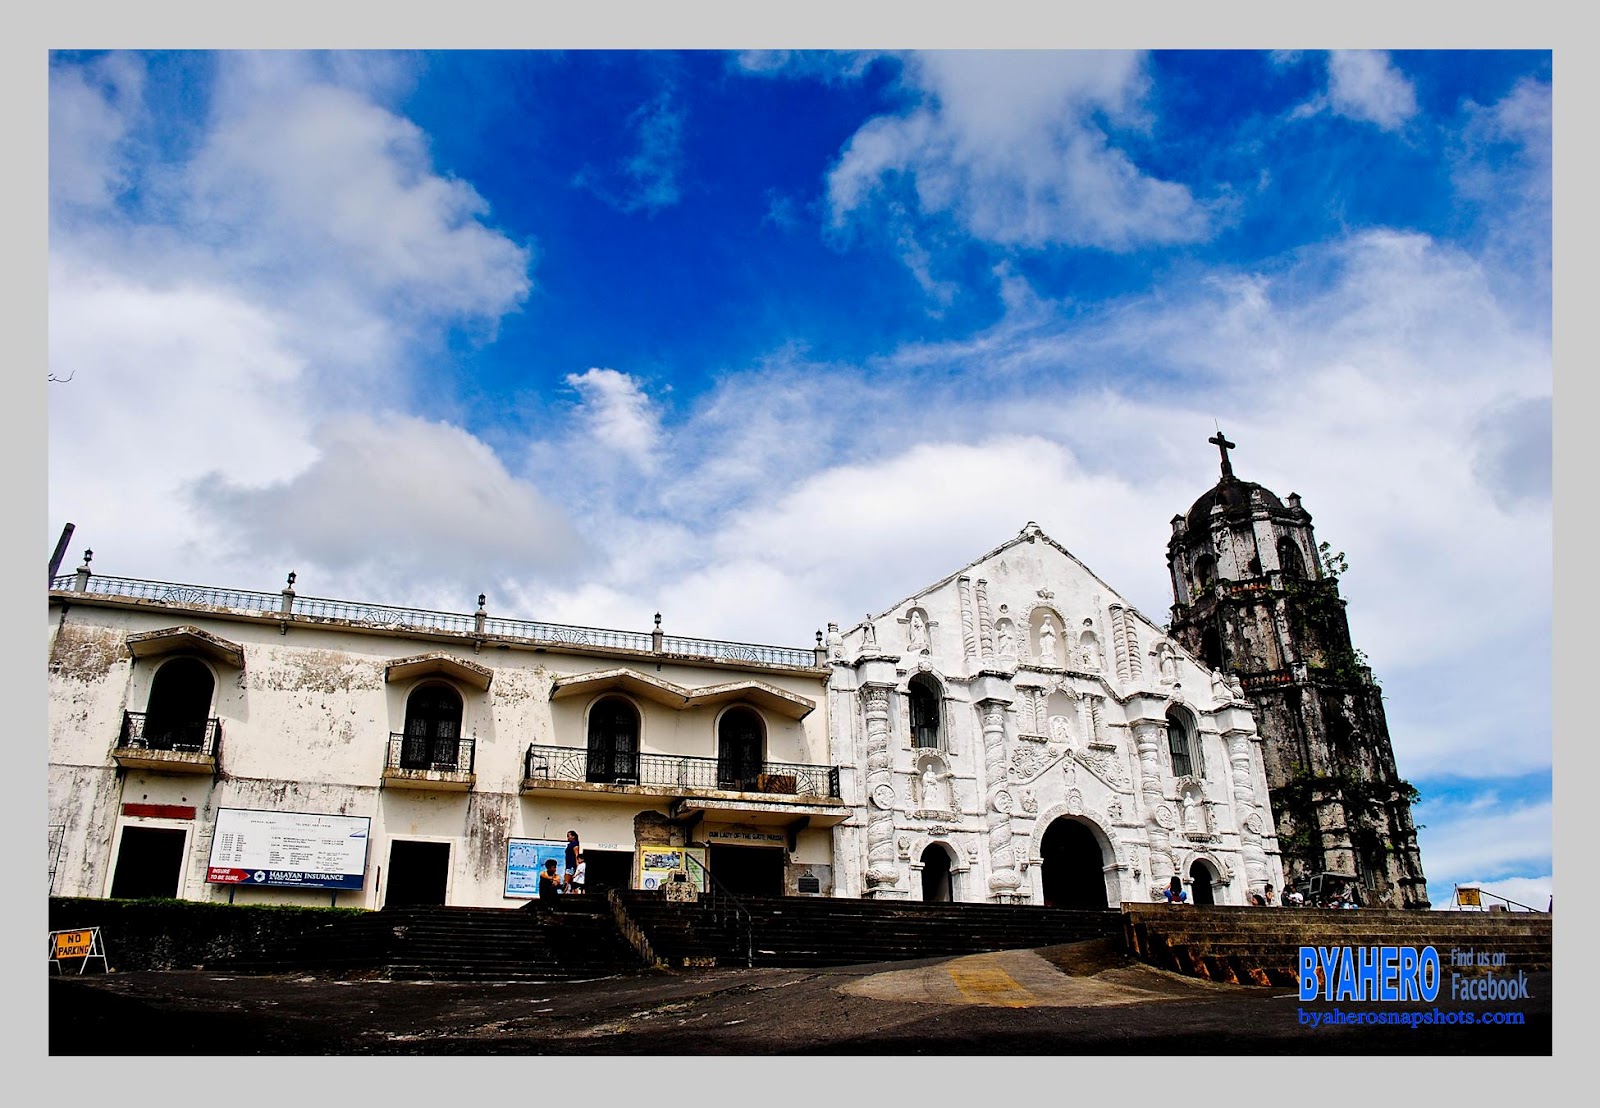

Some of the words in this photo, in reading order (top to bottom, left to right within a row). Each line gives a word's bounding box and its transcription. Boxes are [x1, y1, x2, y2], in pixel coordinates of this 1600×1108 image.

[269, 871, 303, 879] MALAYAN
[304, 872, 344, 881] INSURANCE
[67, 934, 81, 943] NO
[58, 945, 90, 956] PARKING
